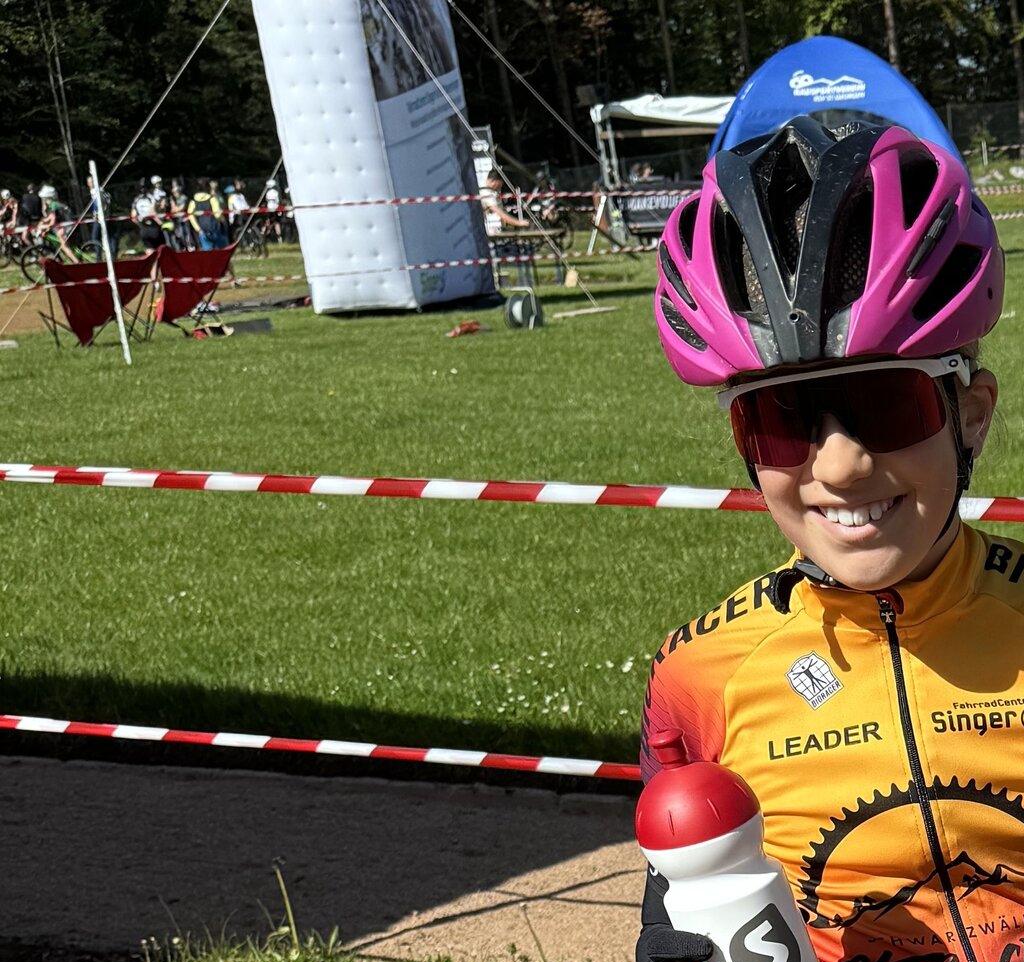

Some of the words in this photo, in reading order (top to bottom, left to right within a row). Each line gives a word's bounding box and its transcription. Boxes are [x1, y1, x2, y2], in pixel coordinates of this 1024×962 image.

[811, 681, 841, 708] BIORACER
[931, 709, 1018, 736] Singer
[767, 720, 883, 761] LEADER
